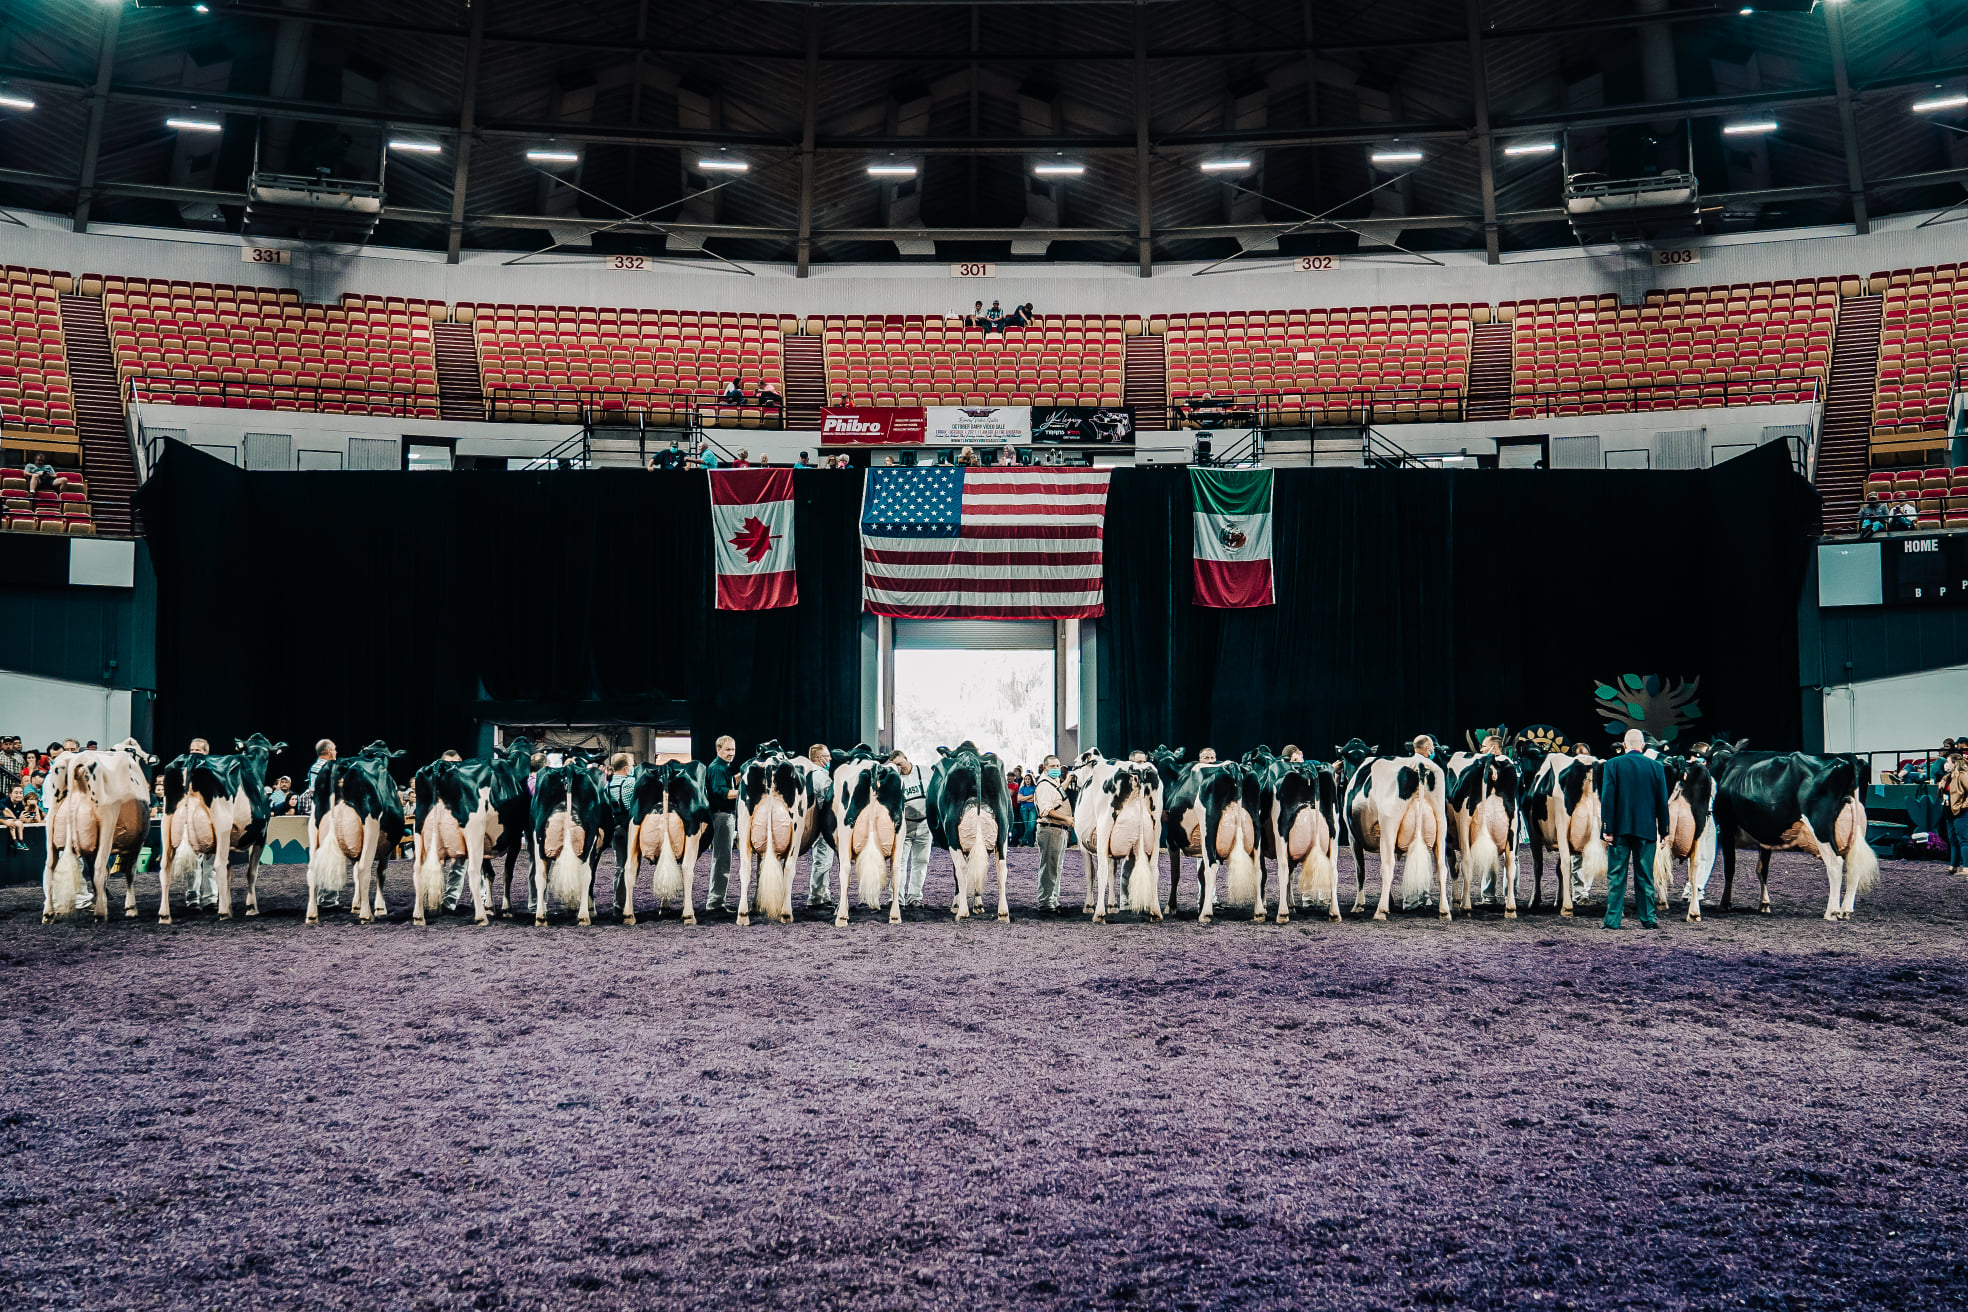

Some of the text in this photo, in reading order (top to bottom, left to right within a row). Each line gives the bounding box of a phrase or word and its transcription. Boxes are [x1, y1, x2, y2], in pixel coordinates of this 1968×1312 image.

[252, 248, 281, 263] 331
[1660, 250, 1692, 265] 303
[614, 256, 645, 270] 332
[960, 263, 986, 276] 301
[1302, 256, 1332, 270] 302
[823, 418, 881, 432] Phibro
[1904, 539, 1939, 553] HOME
[1915, 586, 1947, 598] B P
